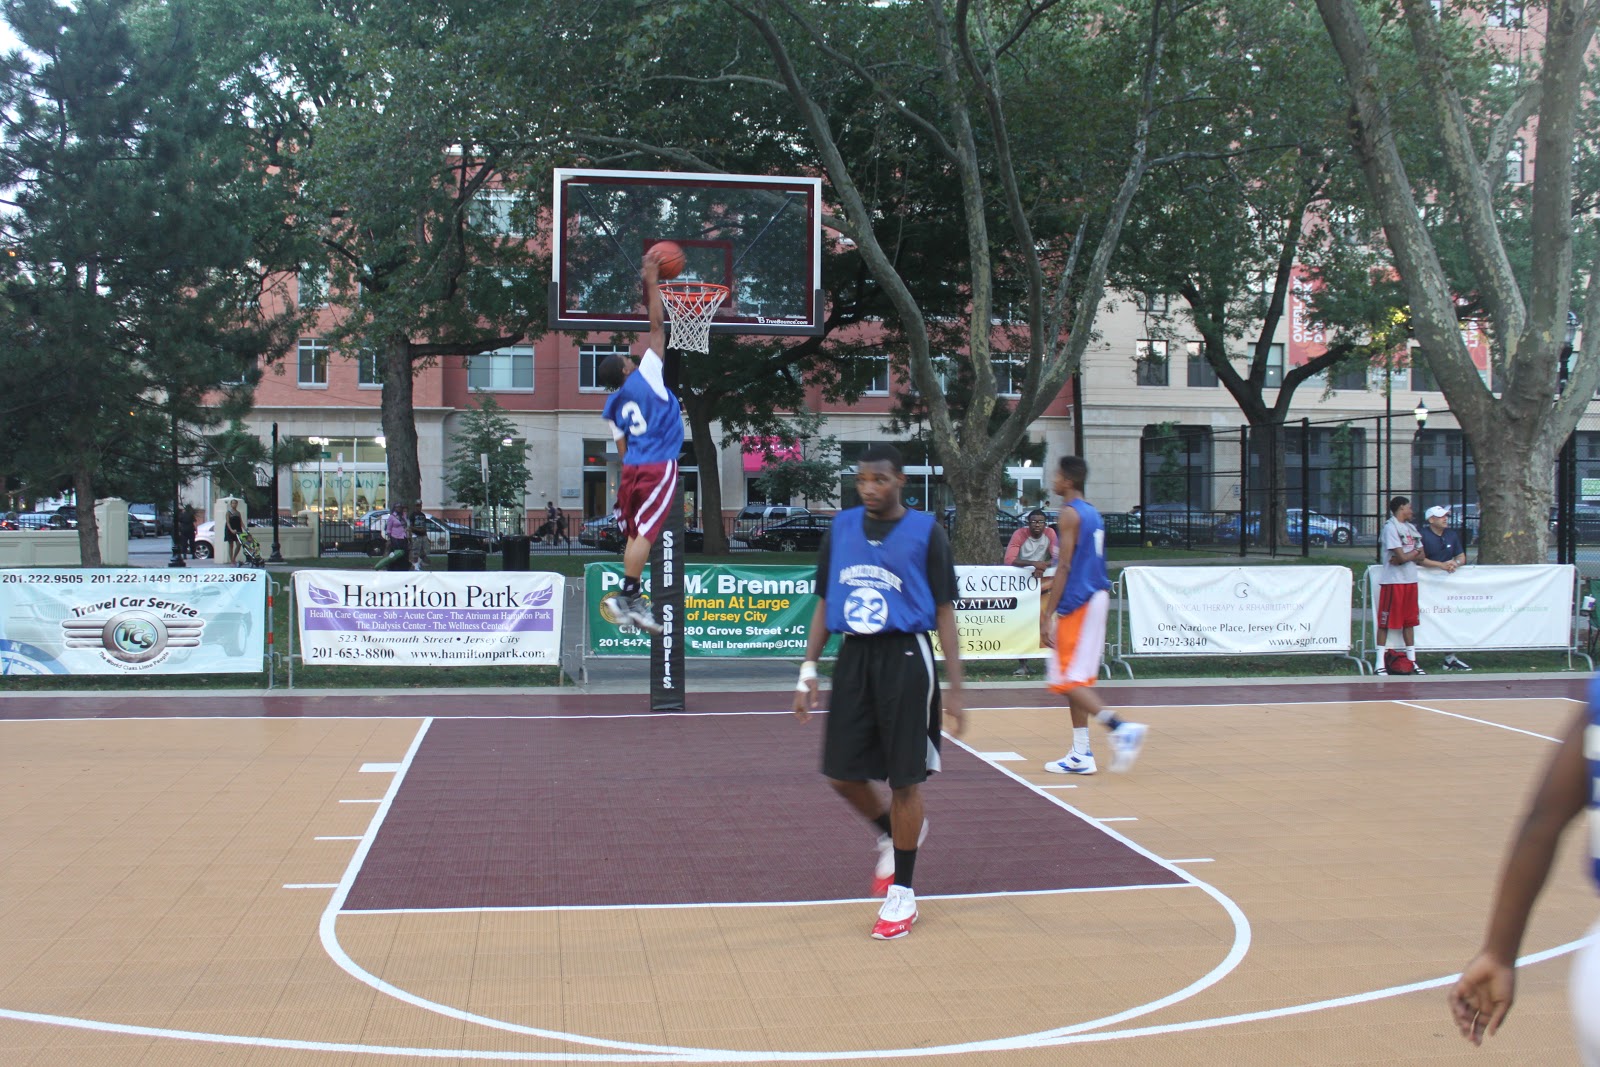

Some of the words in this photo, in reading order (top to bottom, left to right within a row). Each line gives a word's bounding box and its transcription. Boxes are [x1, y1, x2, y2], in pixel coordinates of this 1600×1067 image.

[622, 400, 647, 436] 3
[663, 530, 674, 588] Snap
[2, 574, 84, 584] 201.222.9505
[90, 574, 171, 584] 201.222.1449
[178, 573, 257, 583] 201.222.3062
[965, 576, 977, 592] &
[981, 575, 1039, 592] SCERBO
[343, 584, 457, 608] Hamilton
[465, 584, 520, 608] Park
[72, 597, 117, 618] Travel
[119, 596, 146, 608] Car
[146, 597, 198, 618] Service
[728, 596, 744, 609] At
[748, 596, 790, 611] Large
[969, 599, 982, 609] AT
[987, 599, 1012, 609] LAW
[1433, 605, 1452, 614] Park
[310, 610, 334, 618] Health
[335, 610, 352, 619] Care
[353, 611, 377, 620] Center
[383, 611, 398, 619] Sub
[404, 611, 425, 620] Acute
[427, 612, 444, 620] Care
[450, 612, 465, 620] The
[466, 612, 491, 620] Atrium
[492, 612, 500, 620] at
[534, 611, 551, 620] Park
[848, 595, 883, 625] 22
[686, 611, 699, 621] of
[701, 611, 740, 623] Jersey
[744, 611, 768, 623] City
[356, 621, 371, 629] The
[372, 621, 401, 632] Dialysis
[402, 622, 426, 630] Center
[433, 622, 447, 630] The
[448, 622, 480, 630] Wellness
[481, 622, 506, 630] Center
[618, 625, 641, 636] City
[707, 626, 742, 635] Grove
[745, 626, 782, 635] Street
[791, 625, 805, 635] JC
[1158, 623, 1177, 631] One
[1180, 623, 1217, 632] Nardone
[1220, 623, 1246, 633] Place,
[1248, 623, 1273, 633] Jersey
[1276, 622, 1297, 632] City,
[1300, 623, 1311, 631] NJ
[121, 624, 154, 650] TCS
[337, 634, 358, 644] 523
[360, 635, 420, 644] Monmouth
[422, 635, 453, 644] Street
[463, 635, 496, 646] Jersey
[499, 635, 520, 645] City
[1142, 637, 1207, 647] 201-792-3840
[692, 640, 724, 649] E-Mail
[726, 639, 808, 650] brennanp@JCNJ
[312, 648, 395, 660] 201-653-8800
[410, 648, 546, 662] www.hamiltonpark.com
